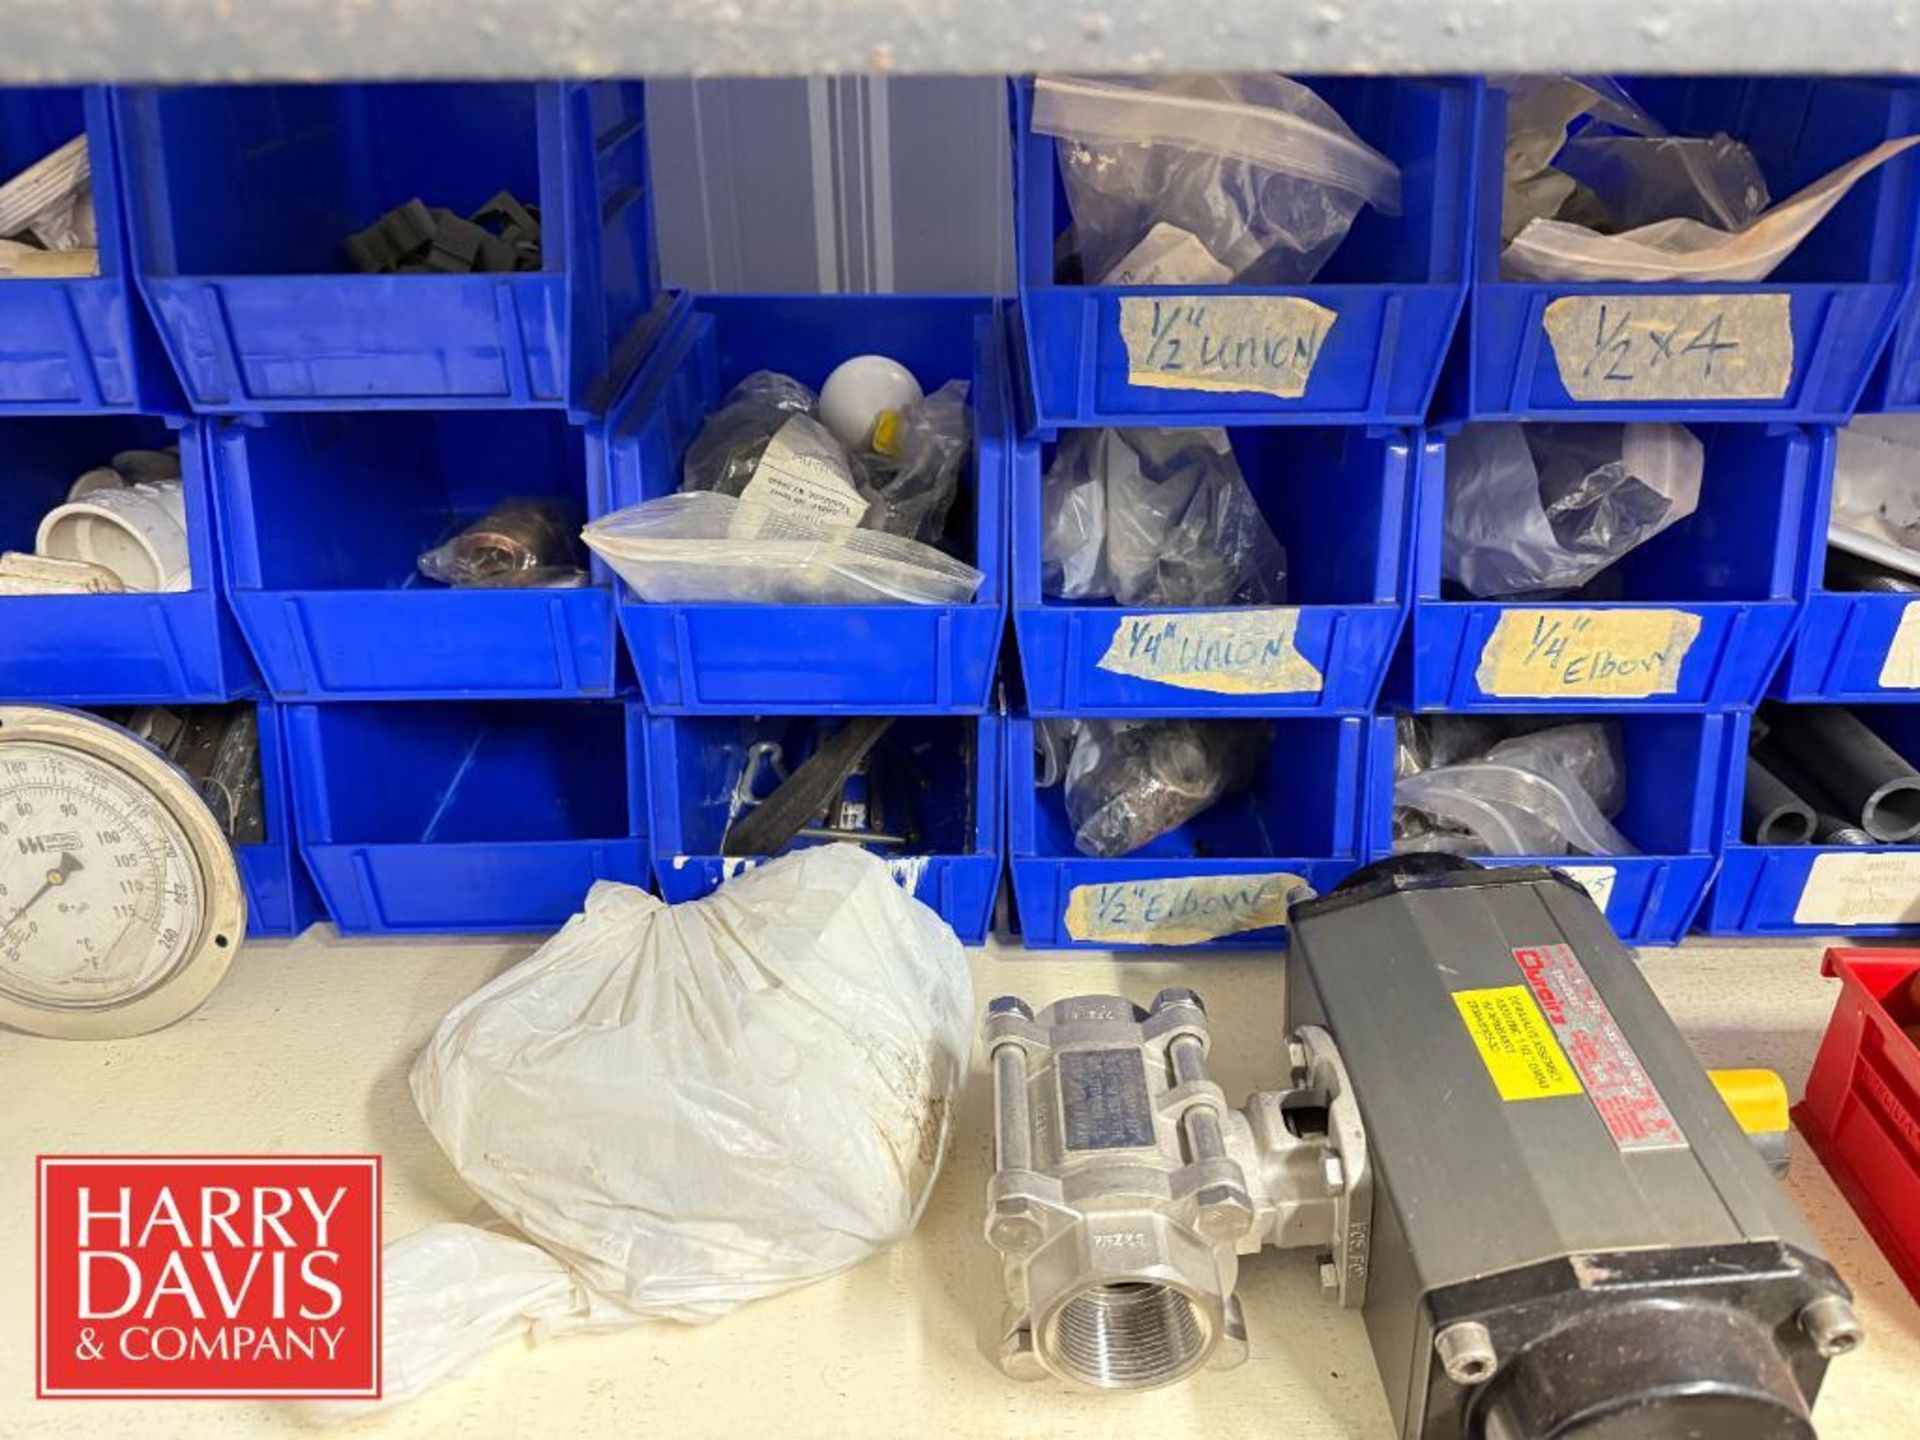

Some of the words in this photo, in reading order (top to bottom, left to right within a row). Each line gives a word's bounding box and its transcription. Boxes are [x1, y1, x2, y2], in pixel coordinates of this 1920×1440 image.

[114, 852, 138, 868] 105
[120, 879, 145, 896] 110
[113, 903, 136, 919] 115
